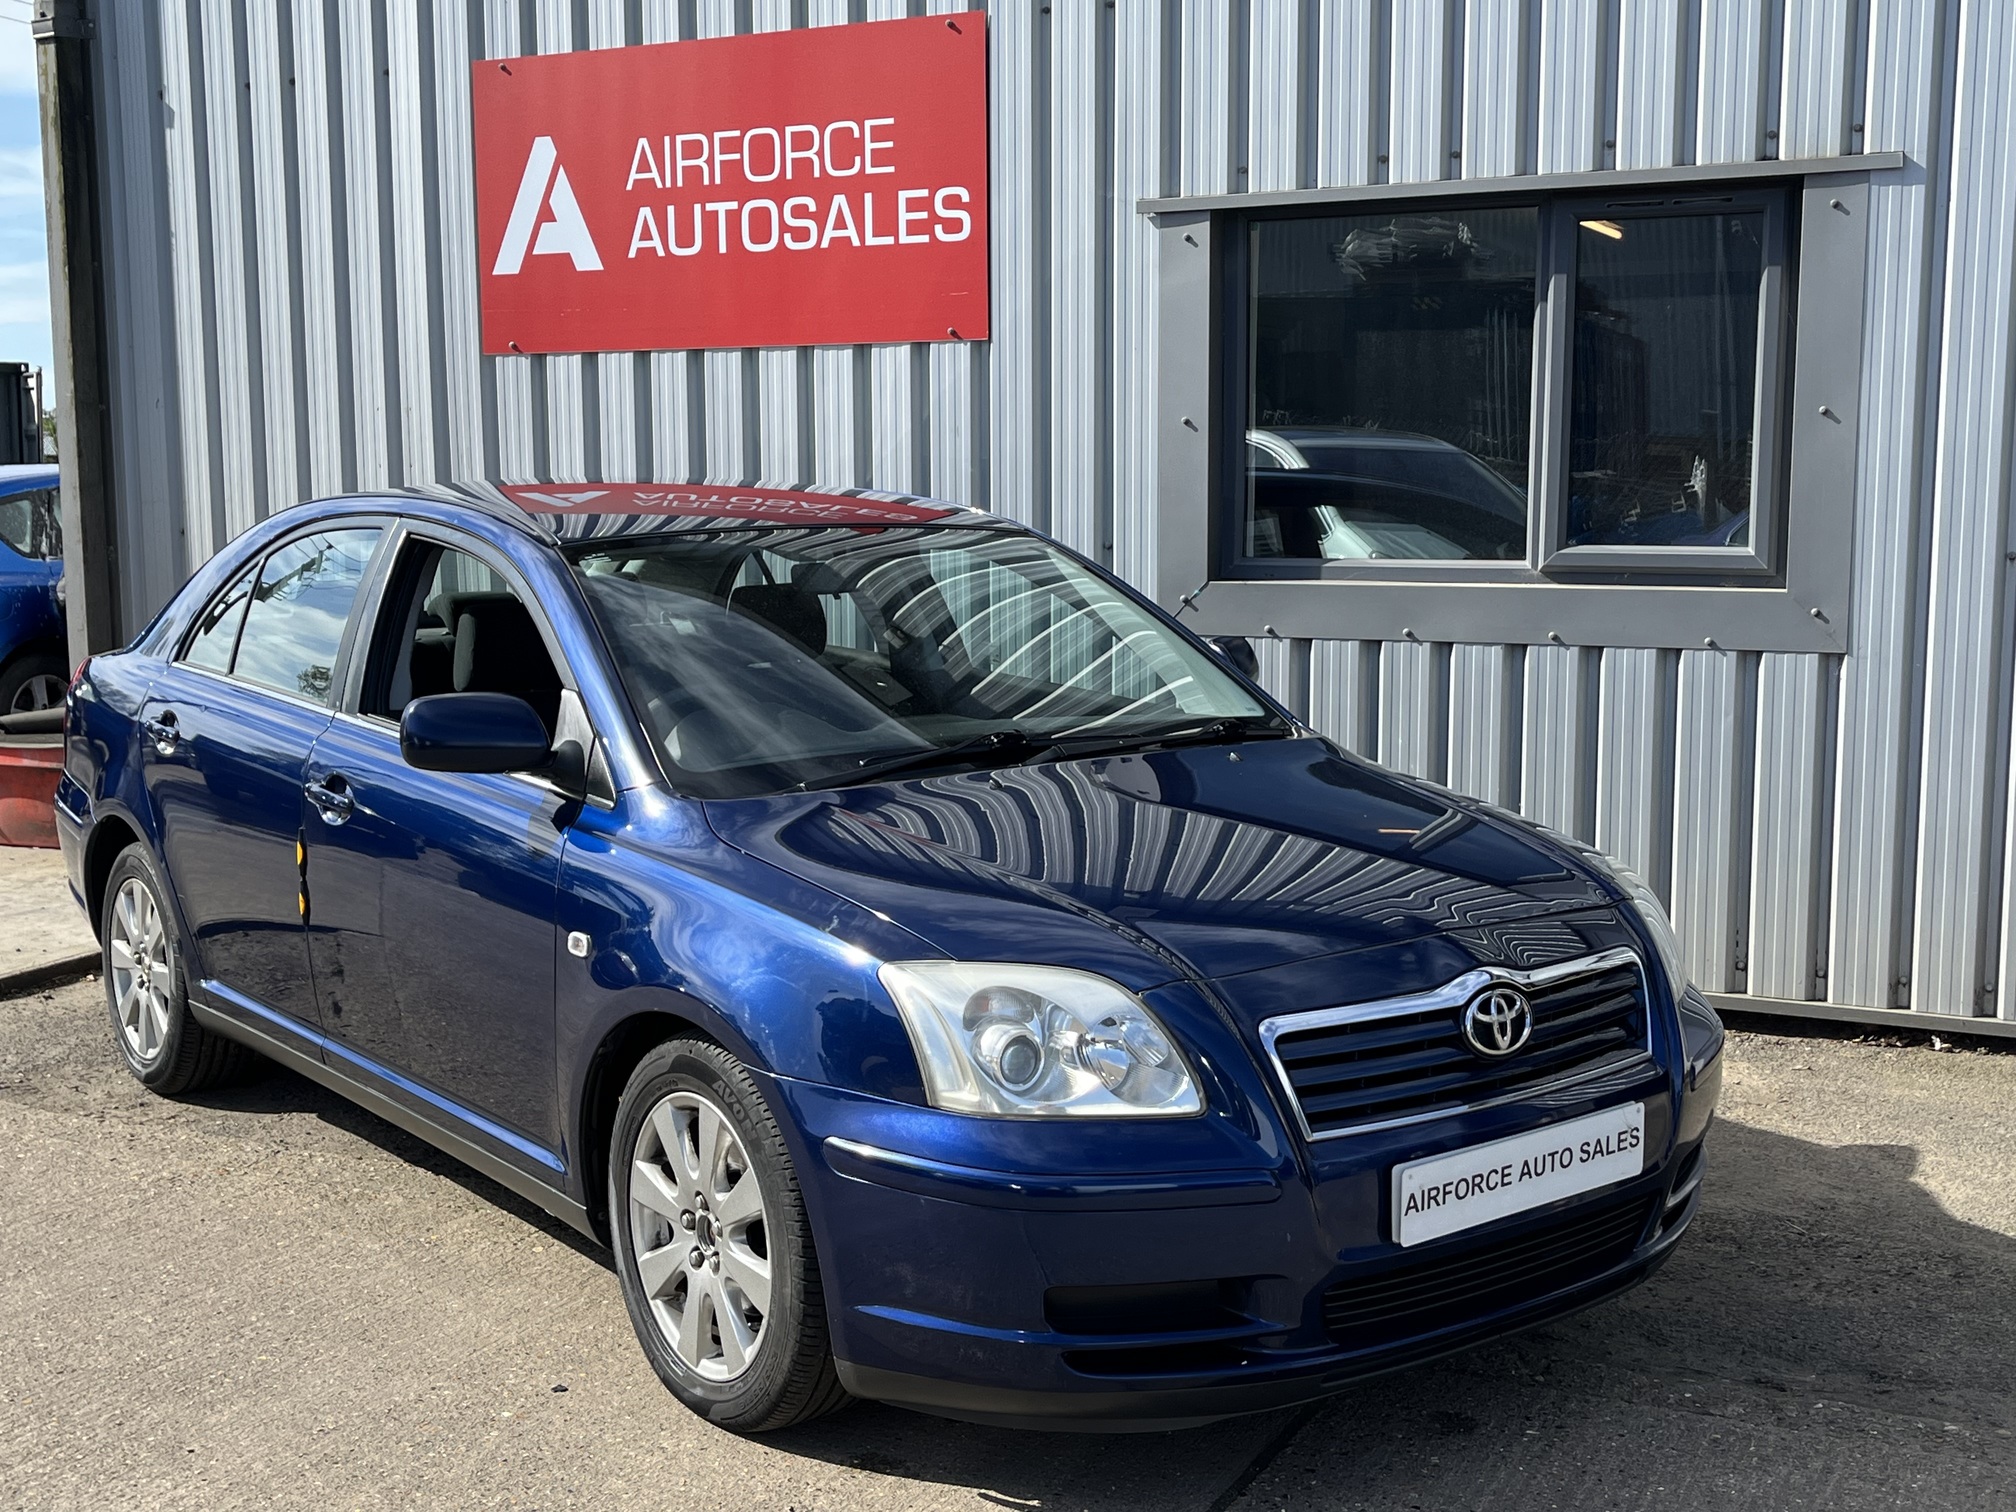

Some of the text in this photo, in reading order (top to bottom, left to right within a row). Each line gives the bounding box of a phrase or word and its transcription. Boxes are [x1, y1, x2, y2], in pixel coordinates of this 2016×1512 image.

[626, 117, 896, 191] AIRFORCE
[491, 135, 605, 275] A
[628, 186, 972, 258] AUTOSALES
[711, 1079, 758, 1140] AVON
[1404, 1126, 1640, 1216] AIRFORCE AUTO SALES
